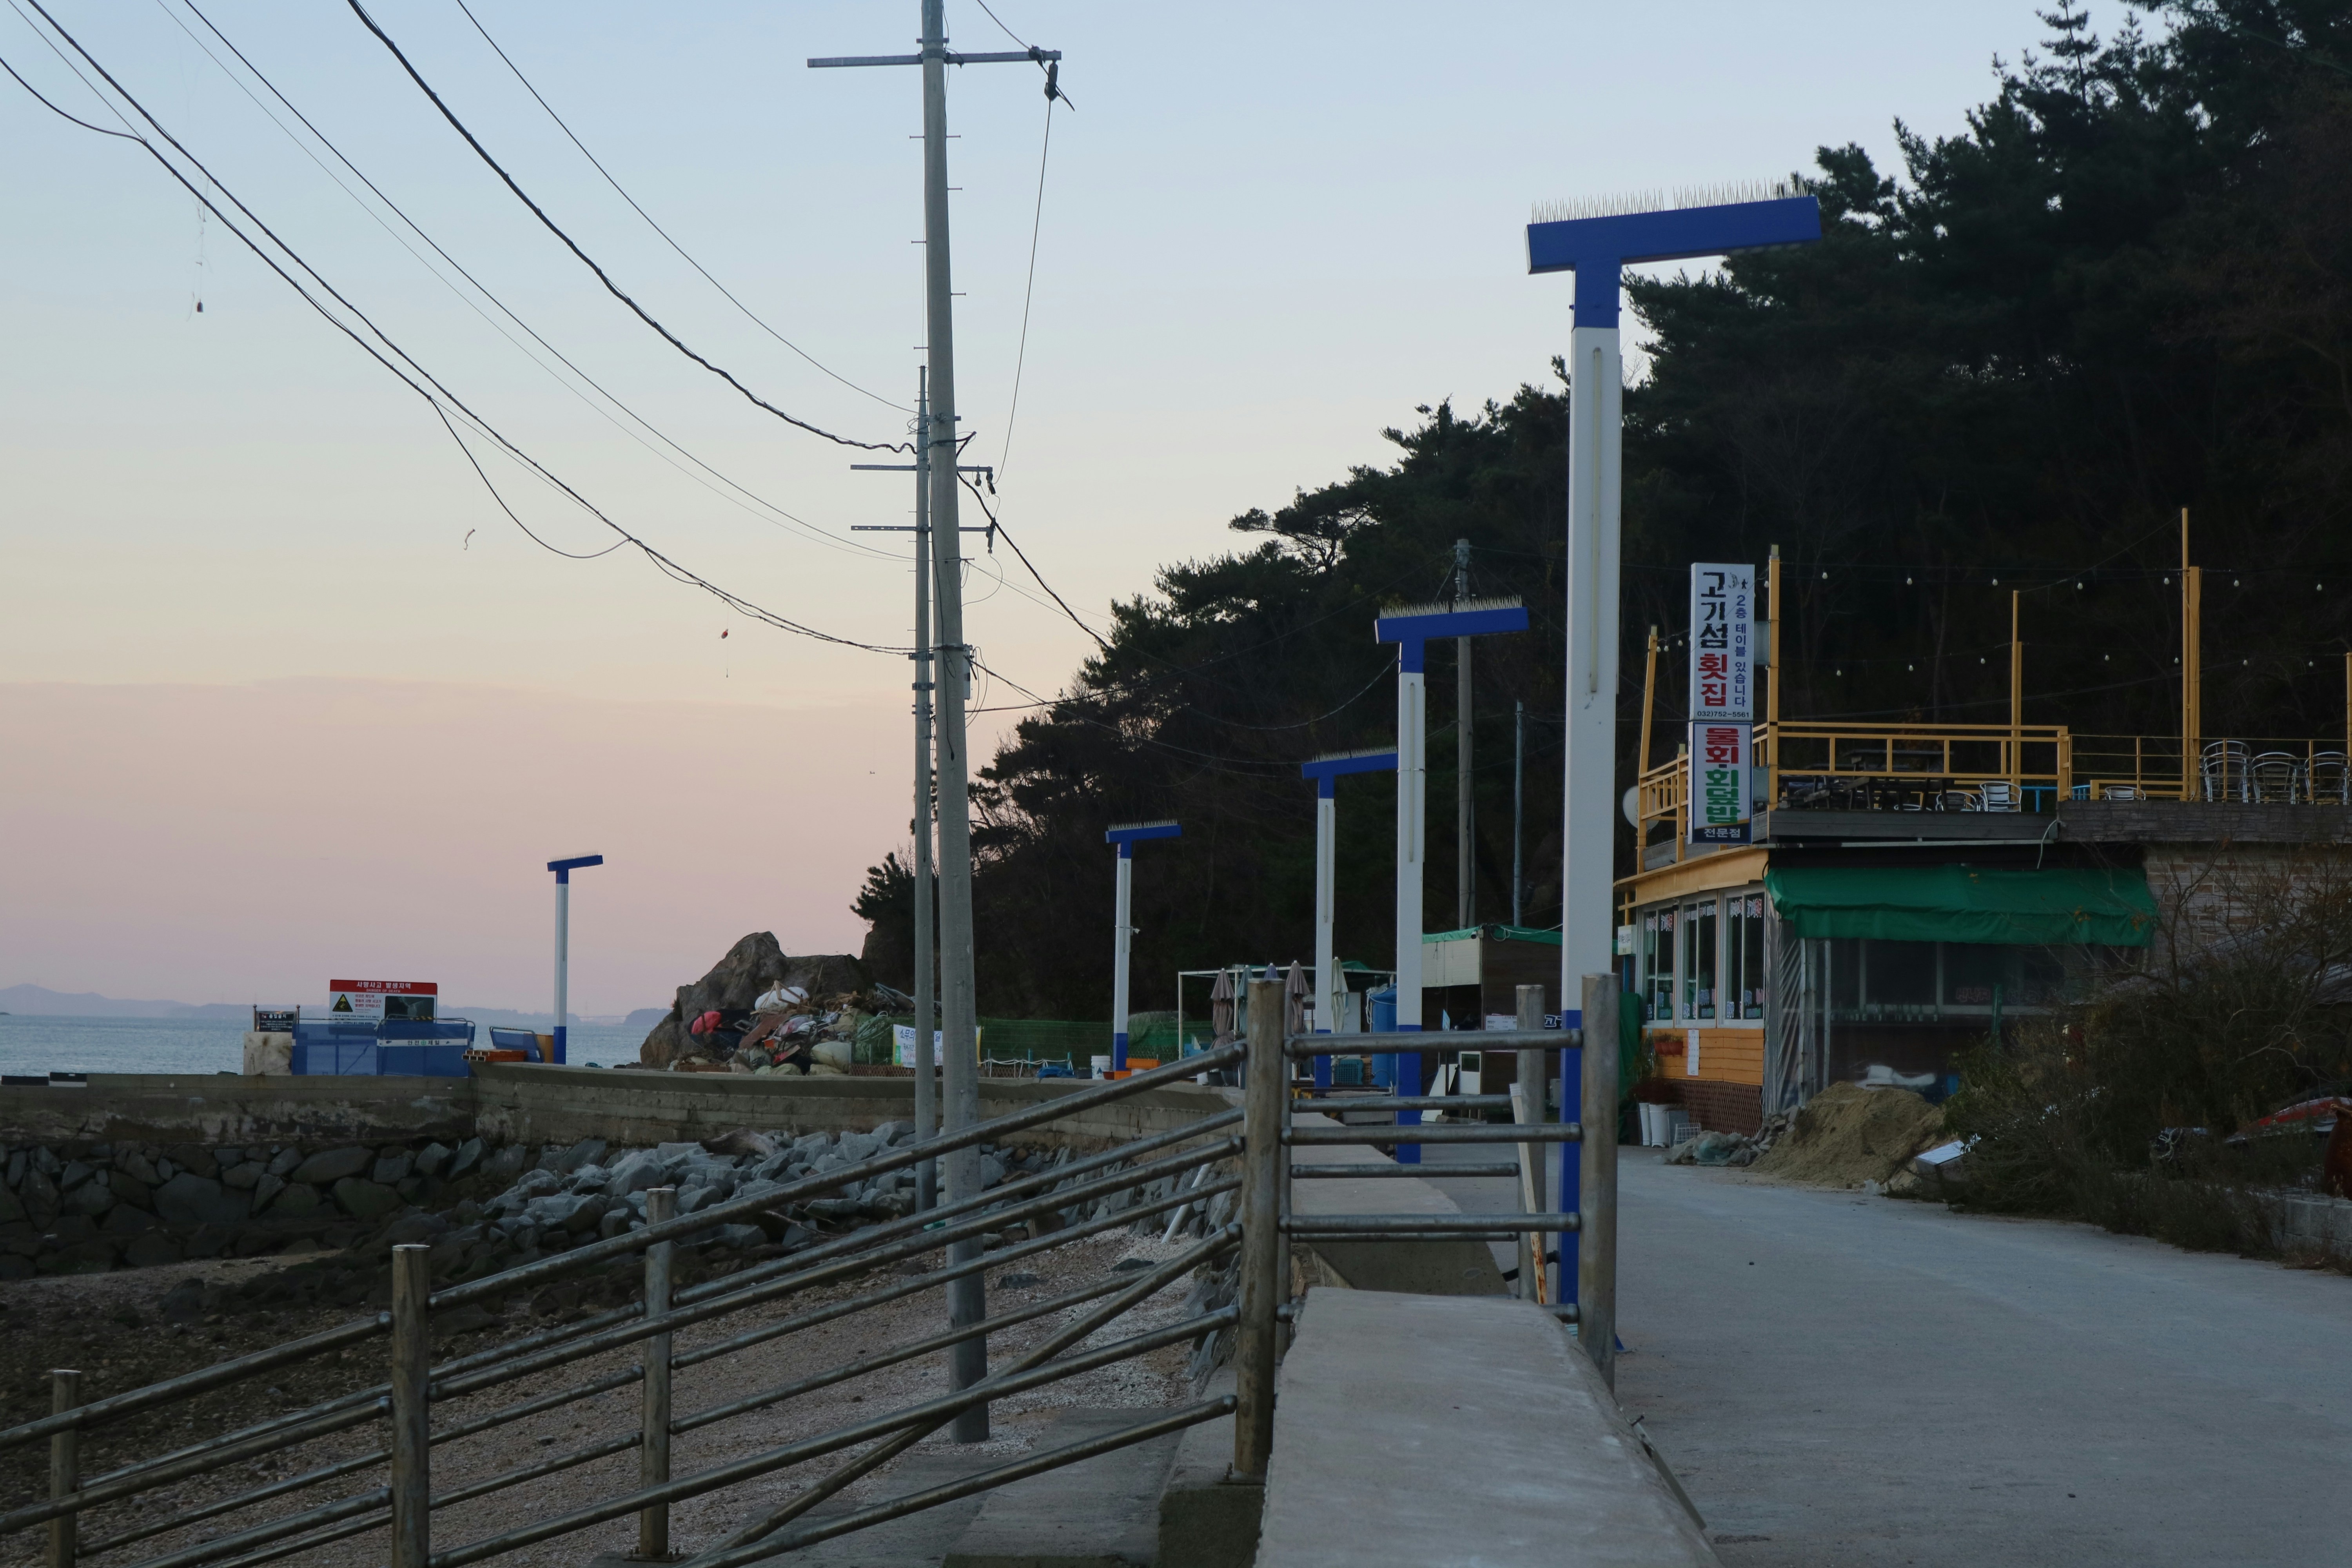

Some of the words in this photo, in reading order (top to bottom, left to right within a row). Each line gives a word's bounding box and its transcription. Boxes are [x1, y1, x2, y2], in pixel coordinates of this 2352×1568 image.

[1699, 572, 1728, 649] 고기섬
[1735, 595, 1747, 619] 2층
[1734, 623, 1746, 657] 테이블
[1698, 653, 1728, 707] 횟집
[1734, 662, 1746, 707] 있습니다
[1705, 728, 1740, 764] 물회
[1705, 769, 1741, 824] 회덮밥
[1704, 828, 1740, 838] 전문점
[900, 1029, 916, 1041] 소무의
